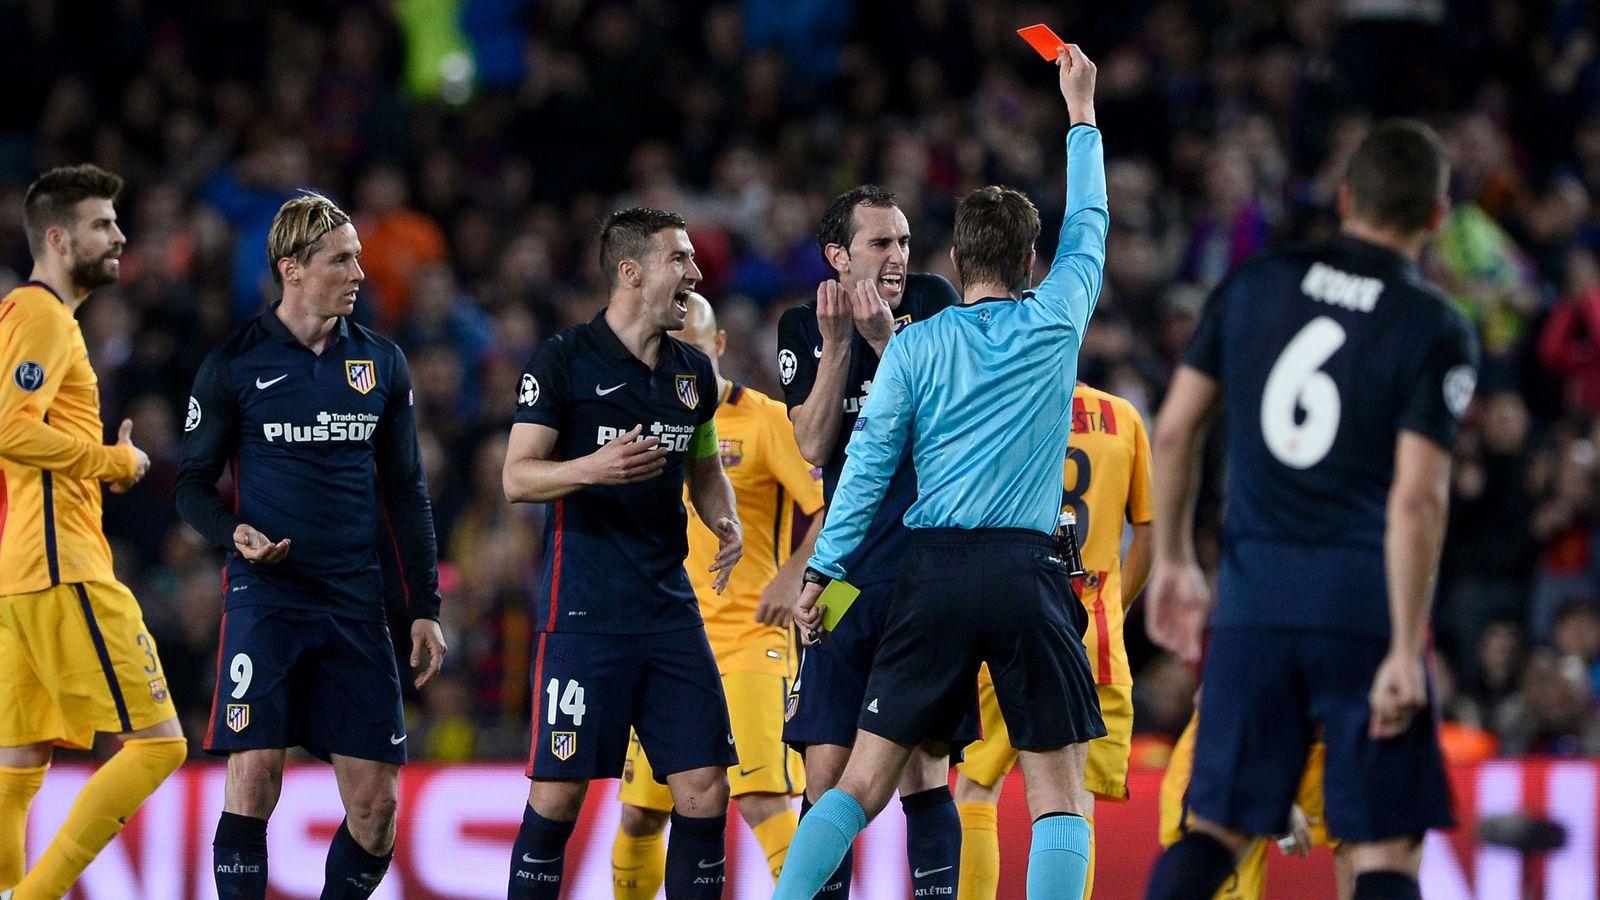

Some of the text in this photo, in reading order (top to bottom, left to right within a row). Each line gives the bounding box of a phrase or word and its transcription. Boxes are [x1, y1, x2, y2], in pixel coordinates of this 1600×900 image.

[1260, 315, 1346, 469] 6
[263, 422, 377, 442] Plus500
[332, 413, 356, 422] Trade
[664, 424, 683, 433] Trade
[136, 633, 157, 675] 3
[230, 652, 253, 699] 9
[546, 677, 586, 726] 14
[914, 886, 953, 897] ATLÉTICO
